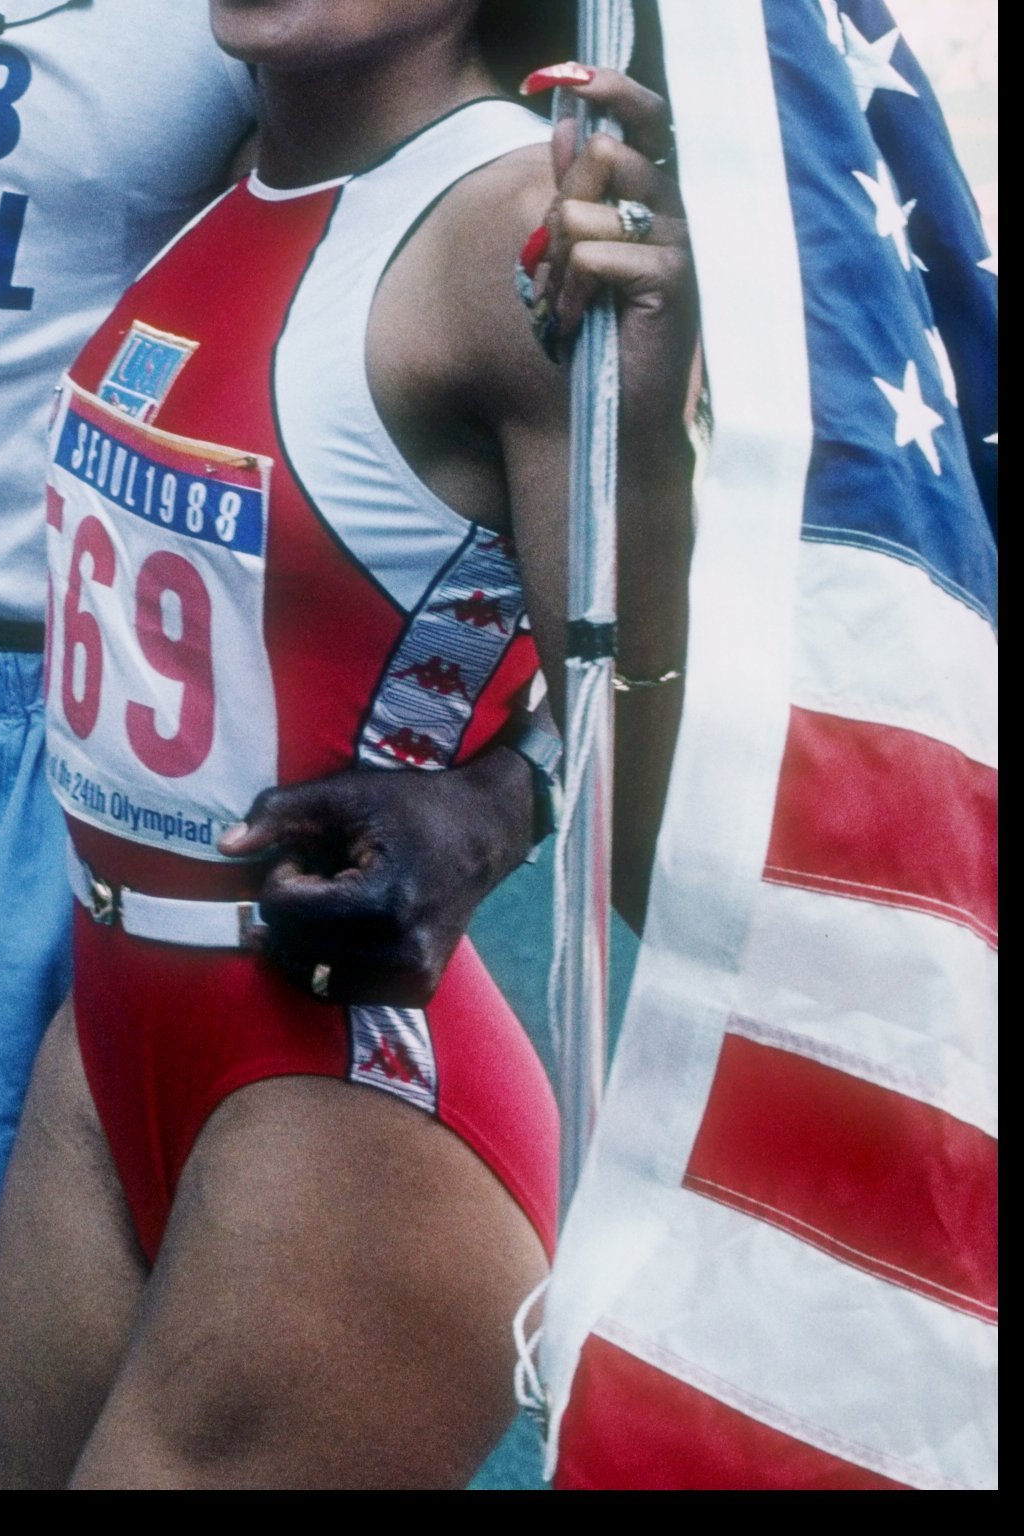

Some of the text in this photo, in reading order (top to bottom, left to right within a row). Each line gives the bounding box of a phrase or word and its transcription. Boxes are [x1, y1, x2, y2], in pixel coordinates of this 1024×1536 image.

[71, 422, 242, 543] SEOUL 1988
[71, 772, 106, 814] 24th
[110, 791, 212, 845] Olympiad
